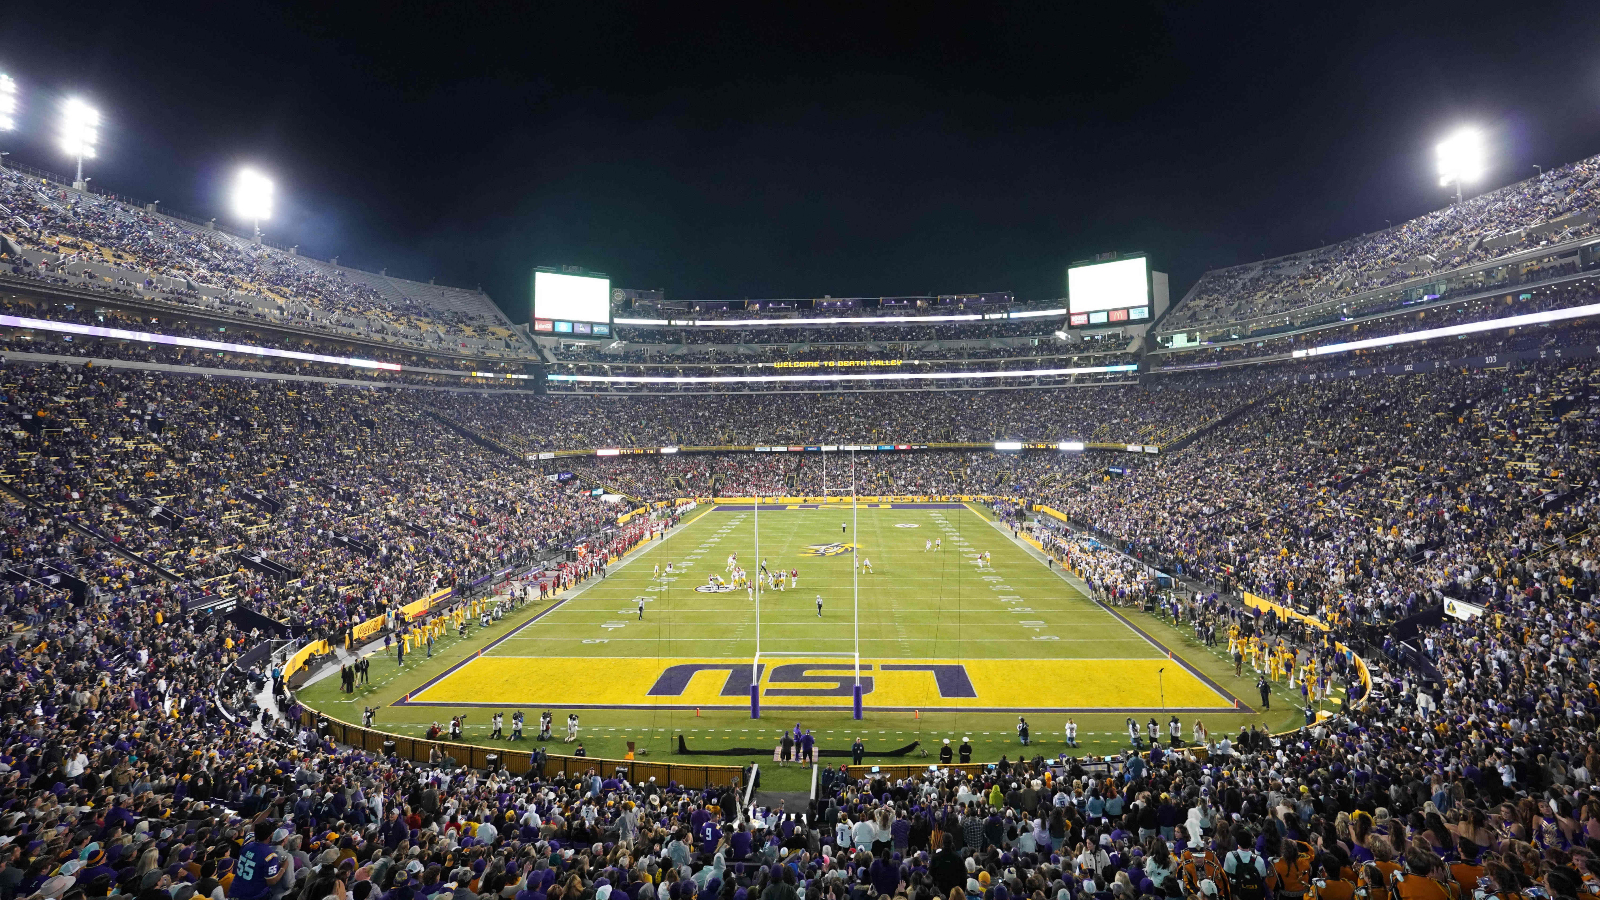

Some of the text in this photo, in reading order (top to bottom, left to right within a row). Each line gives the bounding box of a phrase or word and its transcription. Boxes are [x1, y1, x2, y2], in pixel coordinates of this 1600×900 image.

[1485, 355, 1497, 364] 103
[645, 663, 978, 698] LSU
[705, 827, 712, 841] 9
[236, 854, 257, 881] 55
[268, 864, 278, 875] 55
